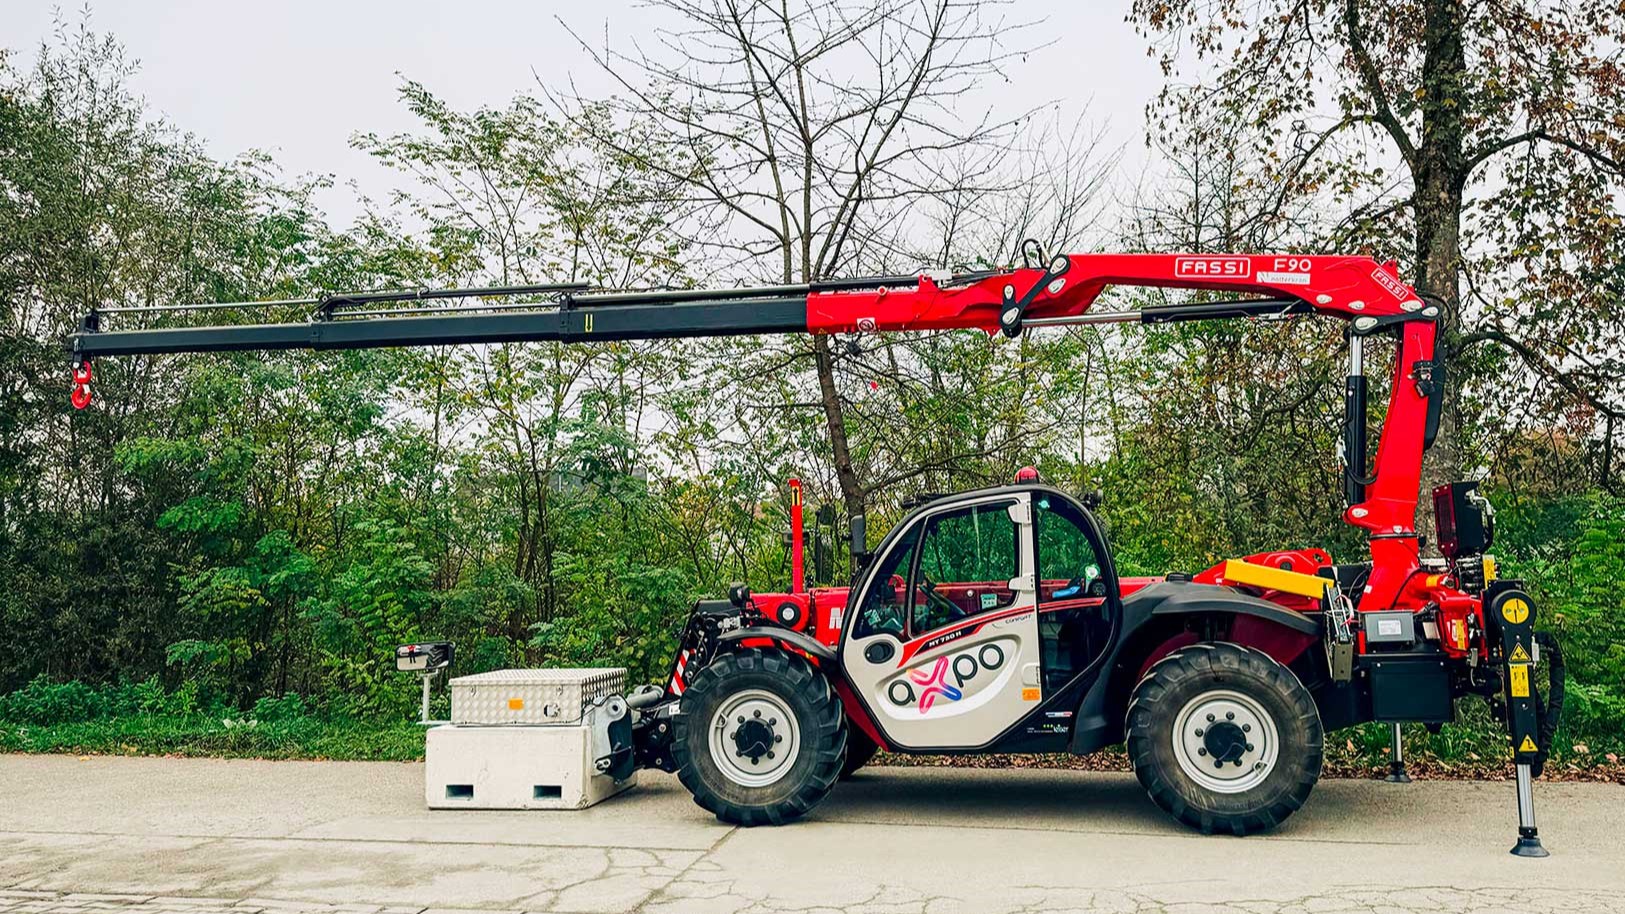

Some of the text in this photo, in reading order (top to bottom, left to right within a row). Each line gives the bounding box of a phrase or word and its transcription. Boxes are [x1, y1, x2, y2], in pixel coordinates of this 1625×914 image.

[1181, 261, 1244, 274] FASSI
[1274, 258, 1311, 272] F90
[1375, 271, 1405, 297] FASSI
[888, 643, 1005, 714] axpo
